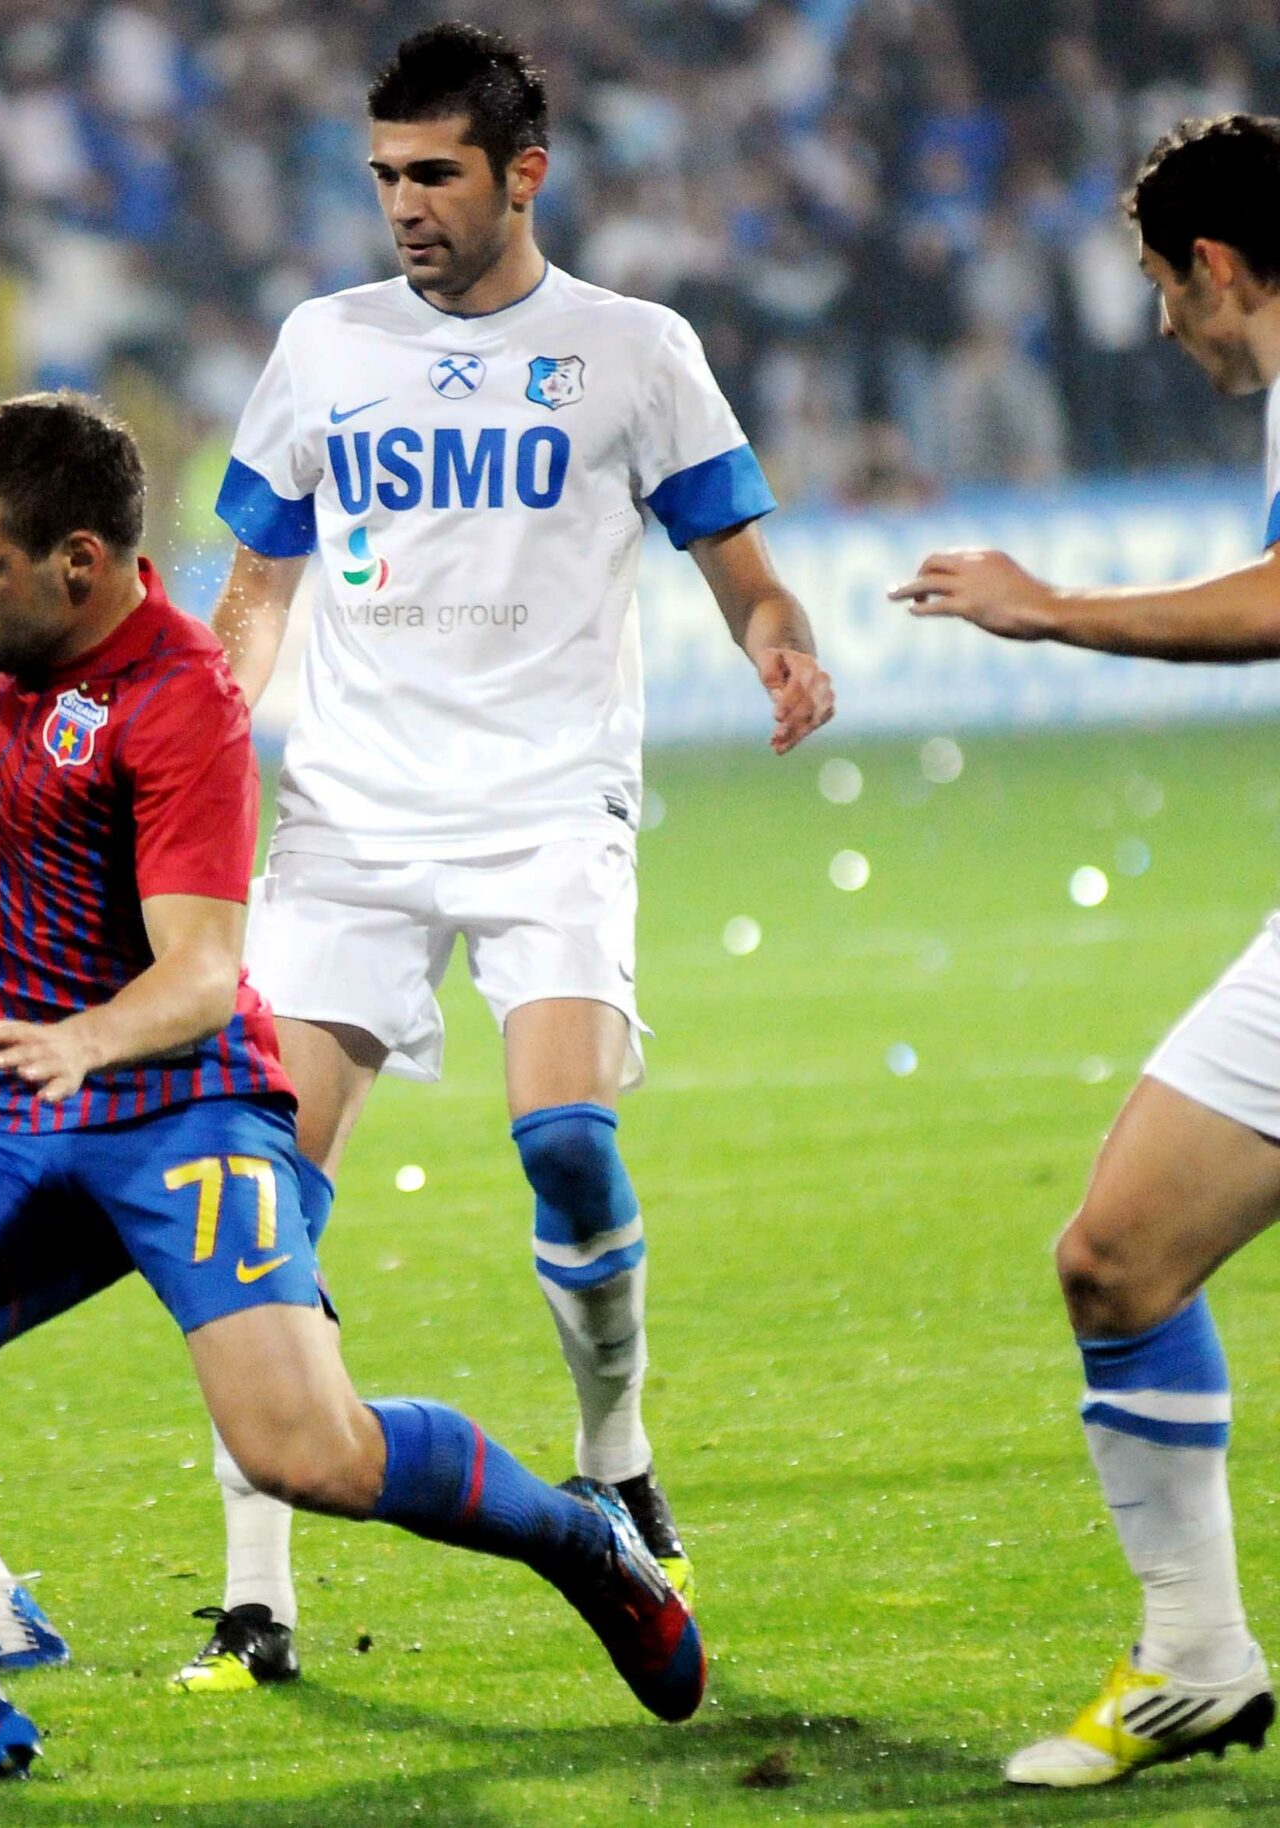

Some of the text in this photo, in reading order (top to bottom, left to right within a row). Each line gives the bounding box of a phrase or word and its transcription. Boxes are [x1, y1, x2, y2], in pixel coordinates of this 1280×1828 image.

[326, 425, 571, 515] USMO
[437, 603, 529, 634] group
[163, 1156, 278, 1263] 77
